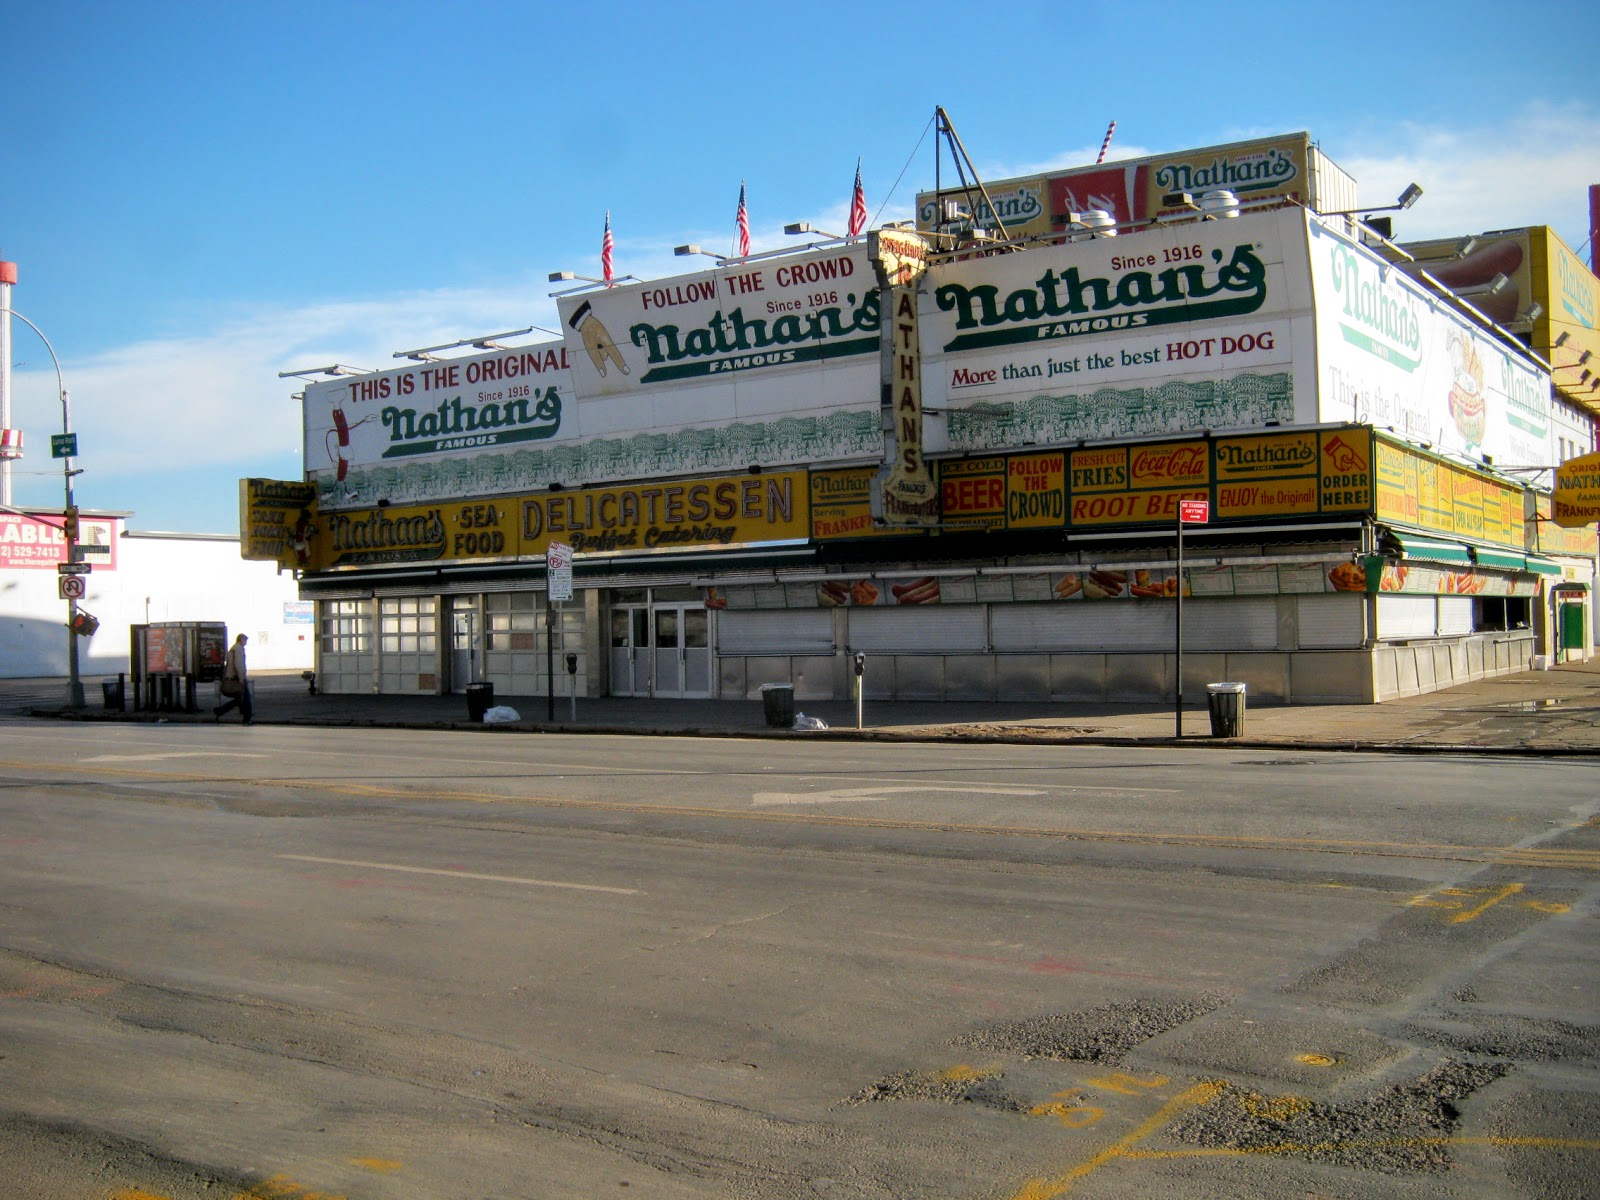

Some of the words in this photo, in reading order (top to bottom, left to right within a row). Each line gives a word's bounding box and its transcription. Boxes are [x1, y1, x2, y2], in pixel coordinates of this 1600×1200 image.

[1156, 150, 1293, 192] Nathan's
[1111, 254, 1155, 271] Since
[1163, 245, 1202, 262] 1916
[642, 280, 716, 310] FOLLOW
[724, 271, 764, 296] THE
[776, 256, 854, 288] CROWD
[935, 244, 1266, 330] Nathan's
[766, 299, 802, 314] Since
[808, 291, 838, 308] 1916
[1331, 243, 1420, 352] Nathan's
[630, 290, 881, 364] Nathan's
[1037, 314, 1150, 338] FAMOUS
[709, 351, 796, 372] FAMOUS
[952, 369, 996, 386] More
[1002, 362, 1043, 380] than
[1046, 359, 1081, 378] just
[1086, 352, 1115, 370] the
[1121, 348, 1160, 367] best
[1166, 338, 1216, 362] HOT
[1221, 332, 1274, 355] DOG
[349, 378, 391, 402] THIS
[396, 373, 414, 396] IS
[420, 365, 460, 390] THE
[466, 347, 570, 384] ORIGINAL
[478, 391, 502, 403] Since
[508, 385, 530, 398] 1916
[1329, 365, 1355, 408] This
[1360, 378, 1370, 413] is
[1374, 386, 1390, 420] the
[1394, 392, 1431, 436] Original
[381, 386, 562, 441] Nathan's
[436, 434, 498, 450] FAMOUS
[1216, 440, 1315, 464] Nathan's
[943, 463, 962, 473] ICE
[967, 460, 1004, 470] COLD
[1009, 456, 1062, 476] FOLLOW
[1072, 454, 1103, 466] FRESH
[1108, 452, 1126, 464] CUT
[1132, 446, 1207, 478] Coca-Cola
[1024, 475, 1048, 490] THE
[1072, 466, 1126, 487] FRIES
[1323, 474, 1368, 488] ORDER
[943, 479, 1005, 511] BEER
[1009, 488, 1062, 521] CROWD
[1072, 496, 1140, 520] ROOT
[1146, 492, 1208, 515] BE
[1220, 488, 1259, 508] ENJOY
[1262, 492, 1274, 504] the
[1277, 488, 1314, 506] Original!
[1323, 490, 1368, 506] HERE!
[460, 505, 498, 528] SEA
[522, 478, 792, 540] DELICATESSEN
[814, 508, 846, 516] Serving
[0, 524, 64, 544] ABLE
[329, 509, 444, 550] Nathan's
[569, 528, 636, 552] Buffet
[644, 522, 737, 548] Catering
[14, 546, 60, 558] 529-7413
[454, 531, 504, 556] FOOD
